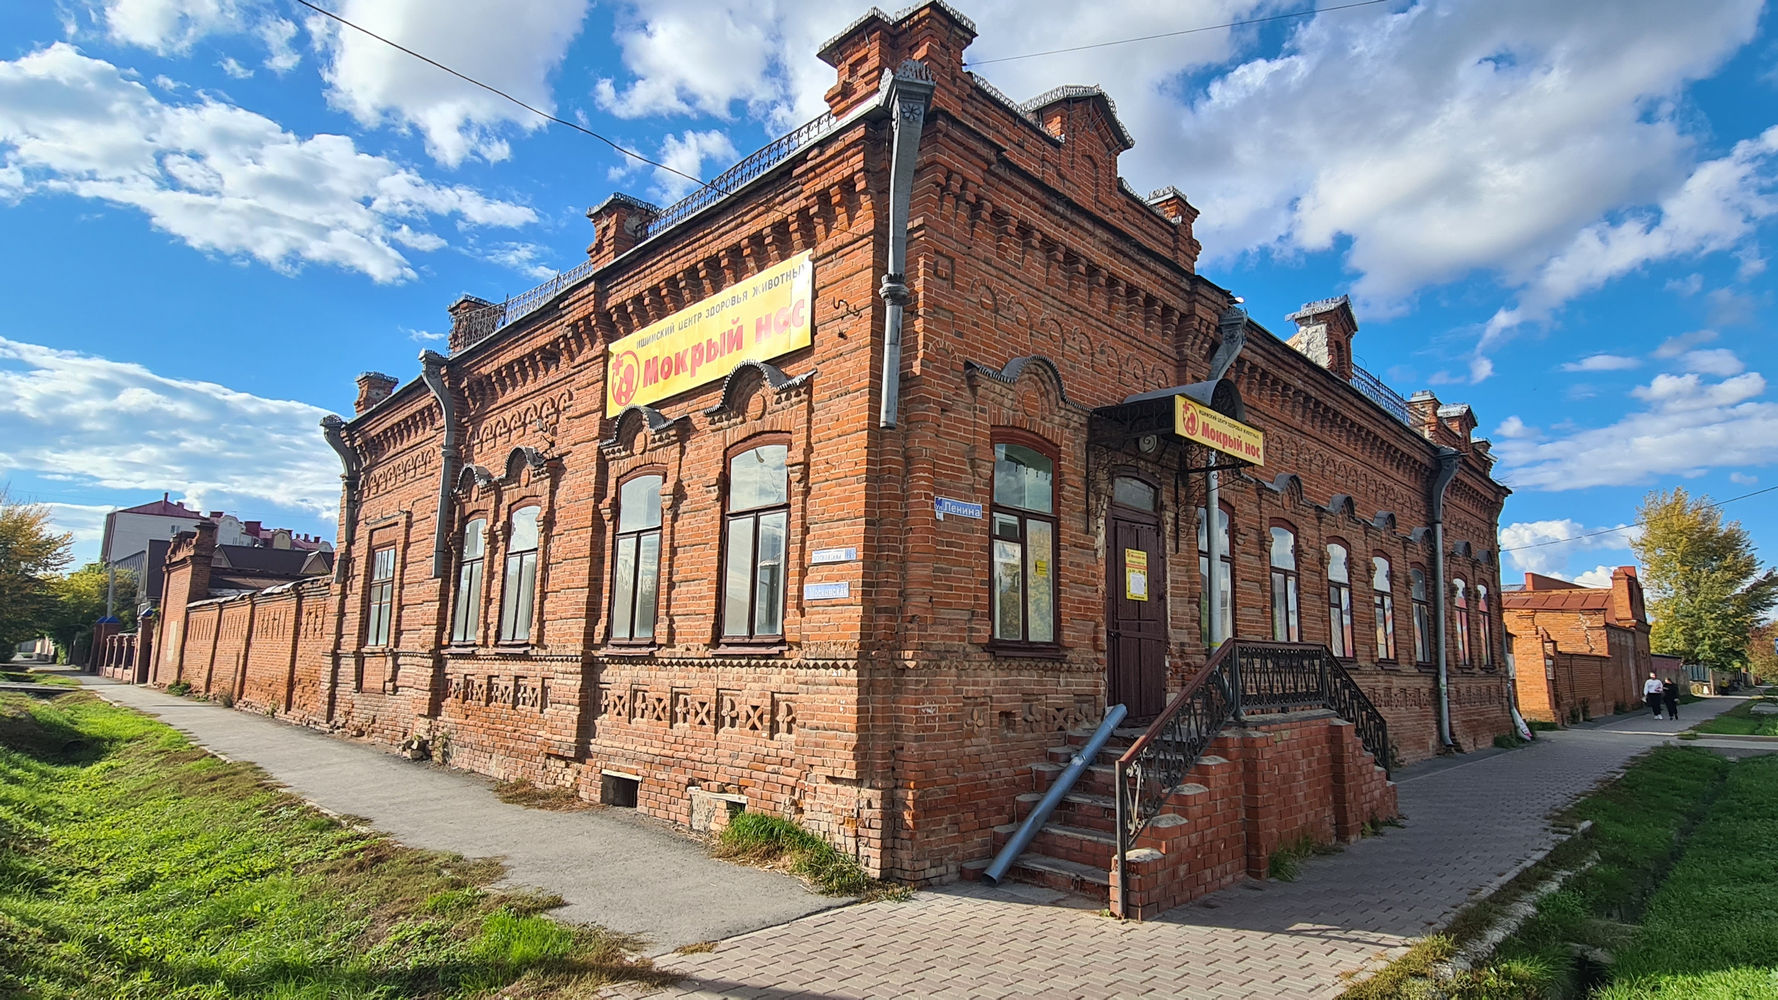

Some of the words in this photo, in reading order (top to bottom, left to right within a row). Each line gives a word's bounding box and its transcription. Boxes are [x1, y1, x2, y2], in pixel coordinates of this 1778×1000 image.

[636, 322, 675, 349] ИШИМСКИЙ
[678, 313, 702, 332] ЦЕНТР
[705, 290, 748, 319] ЗДОРОВЬЯ
[752, 263, 805, 298] ЖИВОТНЫ
[643, 316, 744, 388] Мокрый
[1202, 422, 1243, 452] Мокрый
[1245, 442, 1260, 459] нос
[943, 502, 981, 517] Ленина
